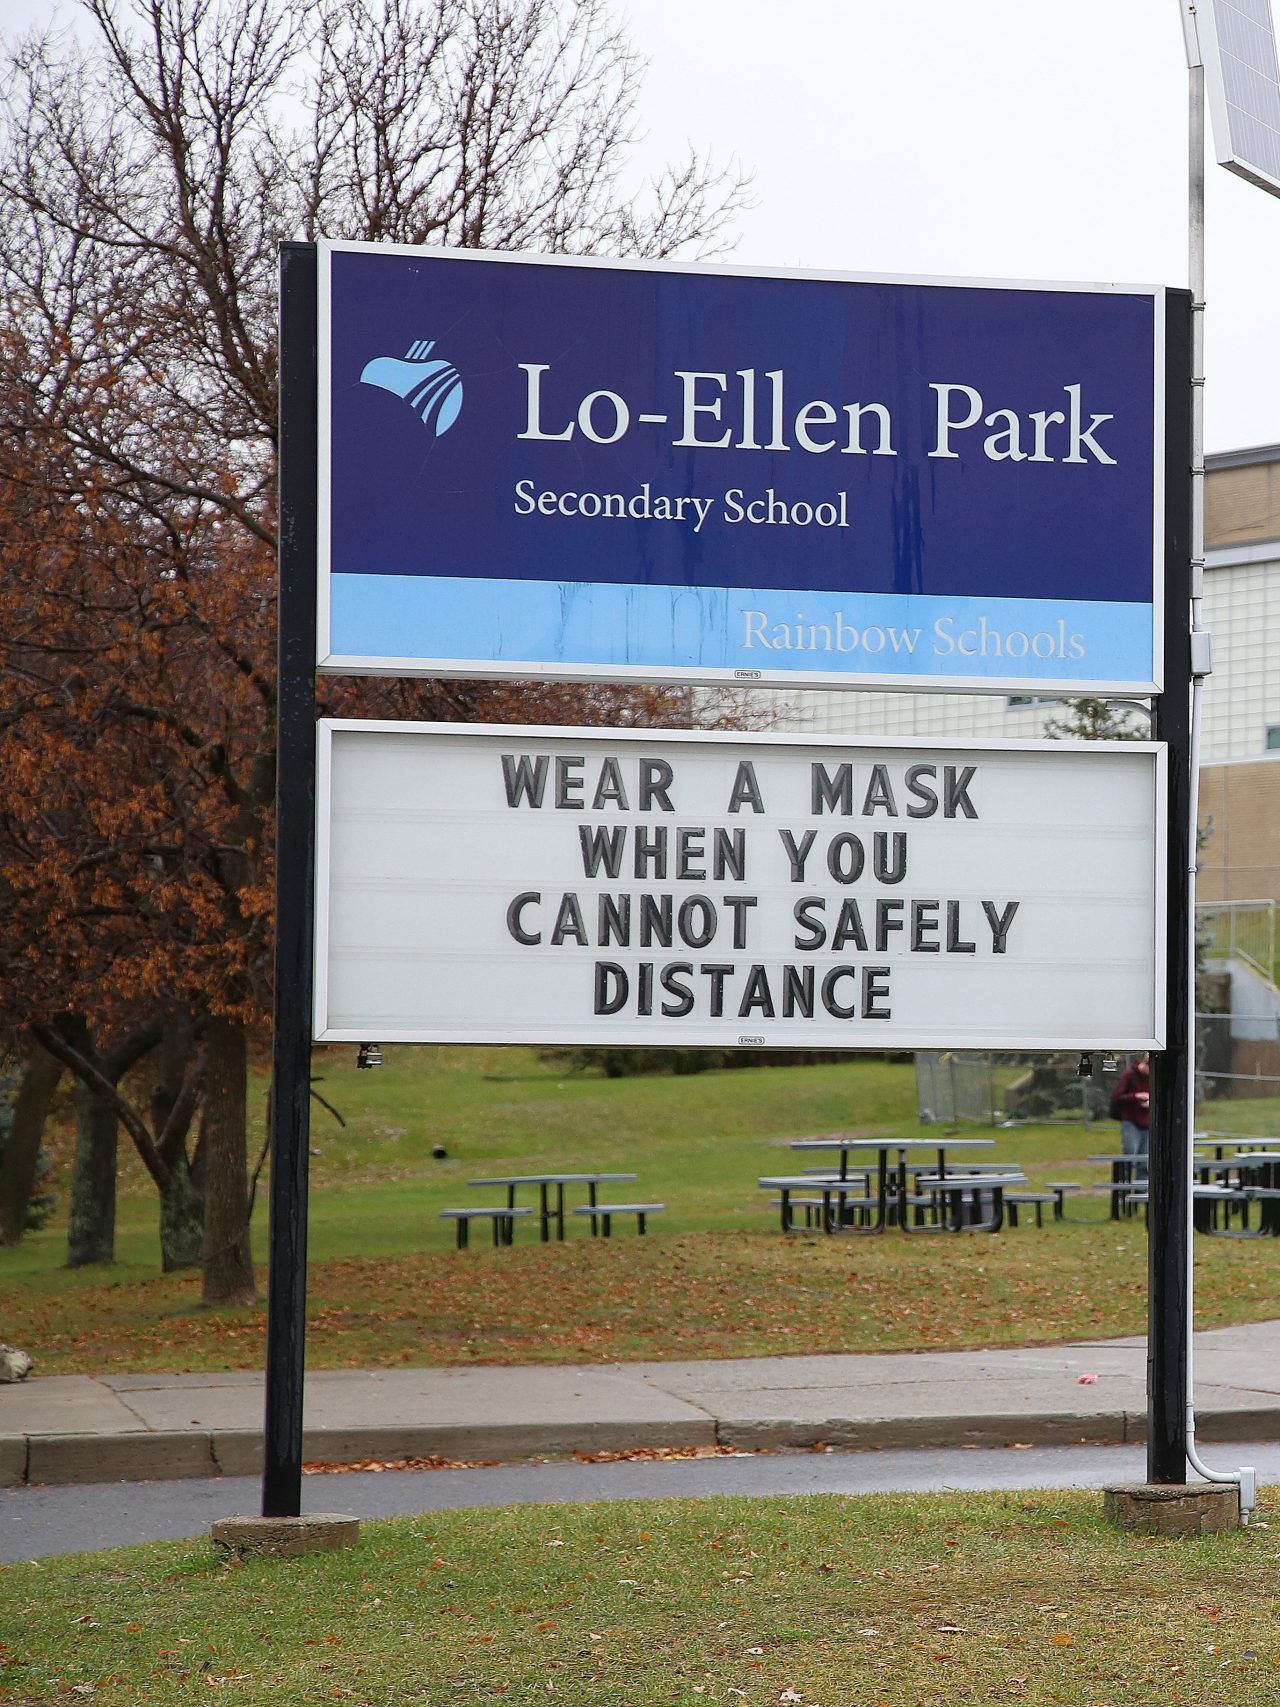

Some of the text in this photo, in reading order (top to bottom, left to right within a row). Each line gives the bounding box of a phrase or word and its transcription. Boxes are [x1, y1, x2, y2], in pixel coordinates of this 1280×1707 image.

[516, 363, 1118, 465] Lo-Ellen Park
[514, 479, 850, 533] Secondary School
[741, 610, 1087, 660] Rainbow Schools
[500, 754, 979, 820] WEAR A MASK
[578, 824, 907, 885] WHEN YOU
[506, 891, 1021, 954] CANNOT SAFELY
[593, 961, 892, 1020] DISTANCE
